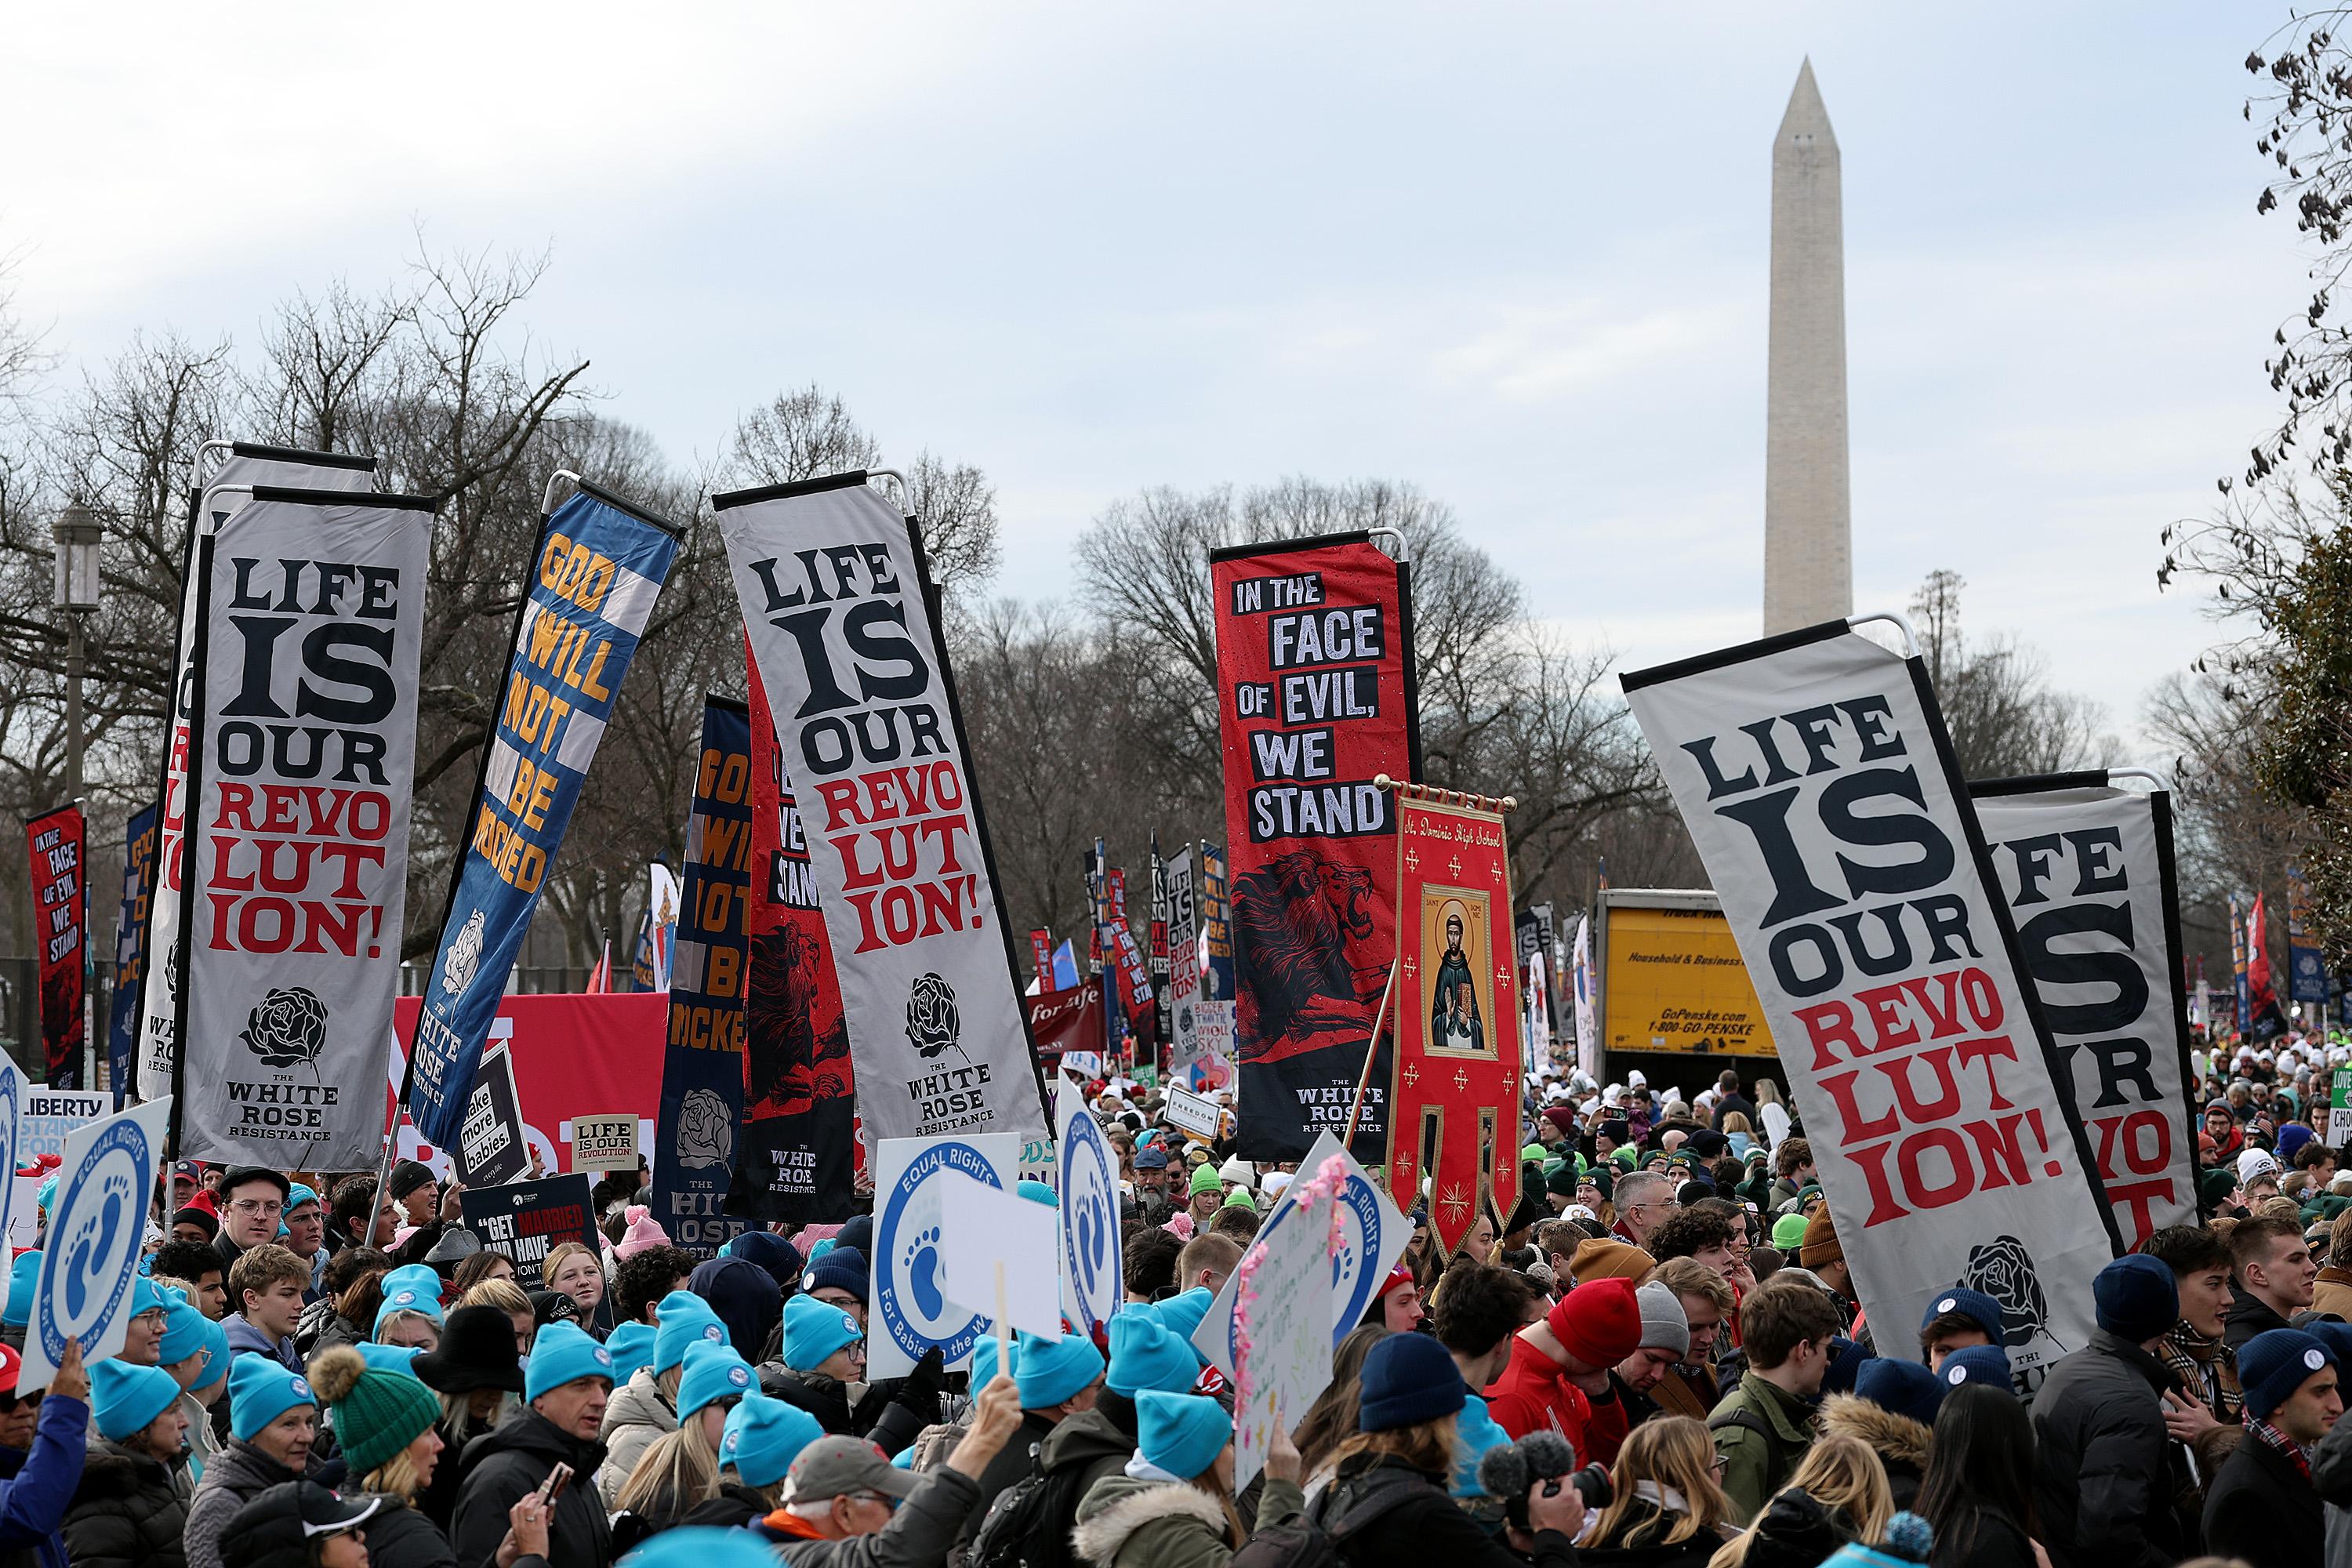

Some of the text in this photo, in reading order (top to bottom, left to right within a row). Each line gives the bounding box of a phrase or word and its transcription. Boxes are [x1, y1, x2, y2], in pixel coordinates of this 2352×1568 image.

[228, 557, 399, 620] LIFE
[539, 532, 615, 613] GOD
[749, 543, 900, 614] LIFE
[1237, 575, 1321, 613] IN THE
[528, 609, 613, 703] WILL
[1273, 608, 1380, 667] FACE
[219, 615, 397, 725] IS
[770, 600, 929, 720] IS
[504, 677, 570, 754] NOT
[1239, 671, 1375, 724] OF EVIL,
[217, 720, 390, 786] OUR
[800, 703, 951, 775] OUR
[1254, 731, 1329, 777] WE
[1679, 694, 1908, 801] LIFE
[512, 757, 560, 831] BE
[699, 749, 752, 807] GO
[814, 760, 964, 833] REVO
[211, 782, 390, 841] REVO
[1254, 785, 1385, 837] STAND
[44, 829, 60, 848] THE
[470, 802, 547, 895] MOCKED
[1405, 815, 1501, 850] St. Dominic High School
[1714, 764, 1955, 930] IS
[48, 842, 77, 876] FACE
[208, 837, 385, 901] LUT
[825, 814, 970, 892] LUT
[1987, 826, 2129, 907] FE
[44, 886, 55, 904] OF
[695, 878, 750, 935] OT
[1169, 889, 1192, 929] IS
[52, 905, 71, 933] WE
[207, 893, 383, 959] ION!
[844, 874, 983, 955] ION!
[1210, 922, 1226, 939] BE
[50, 925, 78, 962] STAND
[1169, 922, 1193, 946] OUR
[1769, 893, 1984, 998] OUR
[706, 946, 746, 998] B
[1171, 956, 1196, 982] LUT
[1628, 952, 1742, 966] Household & Business
[2016, 900, 2150, 1035] S
[435, 1003, 446, 1016] THE
[1133, 983, 1153, 1004] STA
[1031, 1004, 1062, 1025] for
[1648, 1021, 1755, 1036] 1-800-GO-PENSKE
[1661, 1008, 1748, 1022] GoPenske.com
[1791, 967, 2005, 1071] REVO
[1198, 1038, 1221, 1051] SKY
[907, 1063, 991, 1101] WHITE
[930, 1062, 946, 1071] THE
[226, 1081, 338, 1105] WHITE
[466, 1092, 489, 1119] ake
[920, 1089, 984, 1122] ROSE
[1817, 1036, 2018, 1146] LUT
[21, 1118, 91, 1136] STAN
[240, 1105, 321, 1127] ROSE
[463, 1113, 492, 1145] more
[915, 1110, 994, 1137] RESISTANCE
[1173, 1101, 1214, 1121] FREEDOM
[1302, 1123, 1381, 1132] RESISTNCE
[2335, 1111, 2352, 1127] CHO
[20, 1138, 60, 1155] FOR
[229, 1127, 331, 1141] RESISTANCE
[578, 1123, 630, 1139] LIFE
[579, 1138, 631, 1151] IS OUR
[2082, 1109, 2172, 1179] VO
[78, 1125, 145, 1184] EQUAL RIGHTS
[466, 1133, 508, 1171] babies.
[578, 1149, 632, 1159] REVOLUTION!
[902, 1148, 993, 1193] EQUAL RIGHTS
[1844, 1108, 2063, 1229] ION!
[777, 1167, 813, 1184] ROE
[517, 1204, 583, 1237] MARRIED
[676, 1219, 745, 1243] OSE
[1357, 1195, 1377, 1256] RIGHTS
[514, 1235, 549, 1262] HAVE
[517, 1263, 542, 1276] ON'T
[42, 1293, 51, 1328] For
[102, 1261, 133, 1324] Womb
[550, 1305, 567, 1318] SILVER
[881, 1288, 971, 1358] For Babie the
[43, 1330, 66, 1363] Babie
